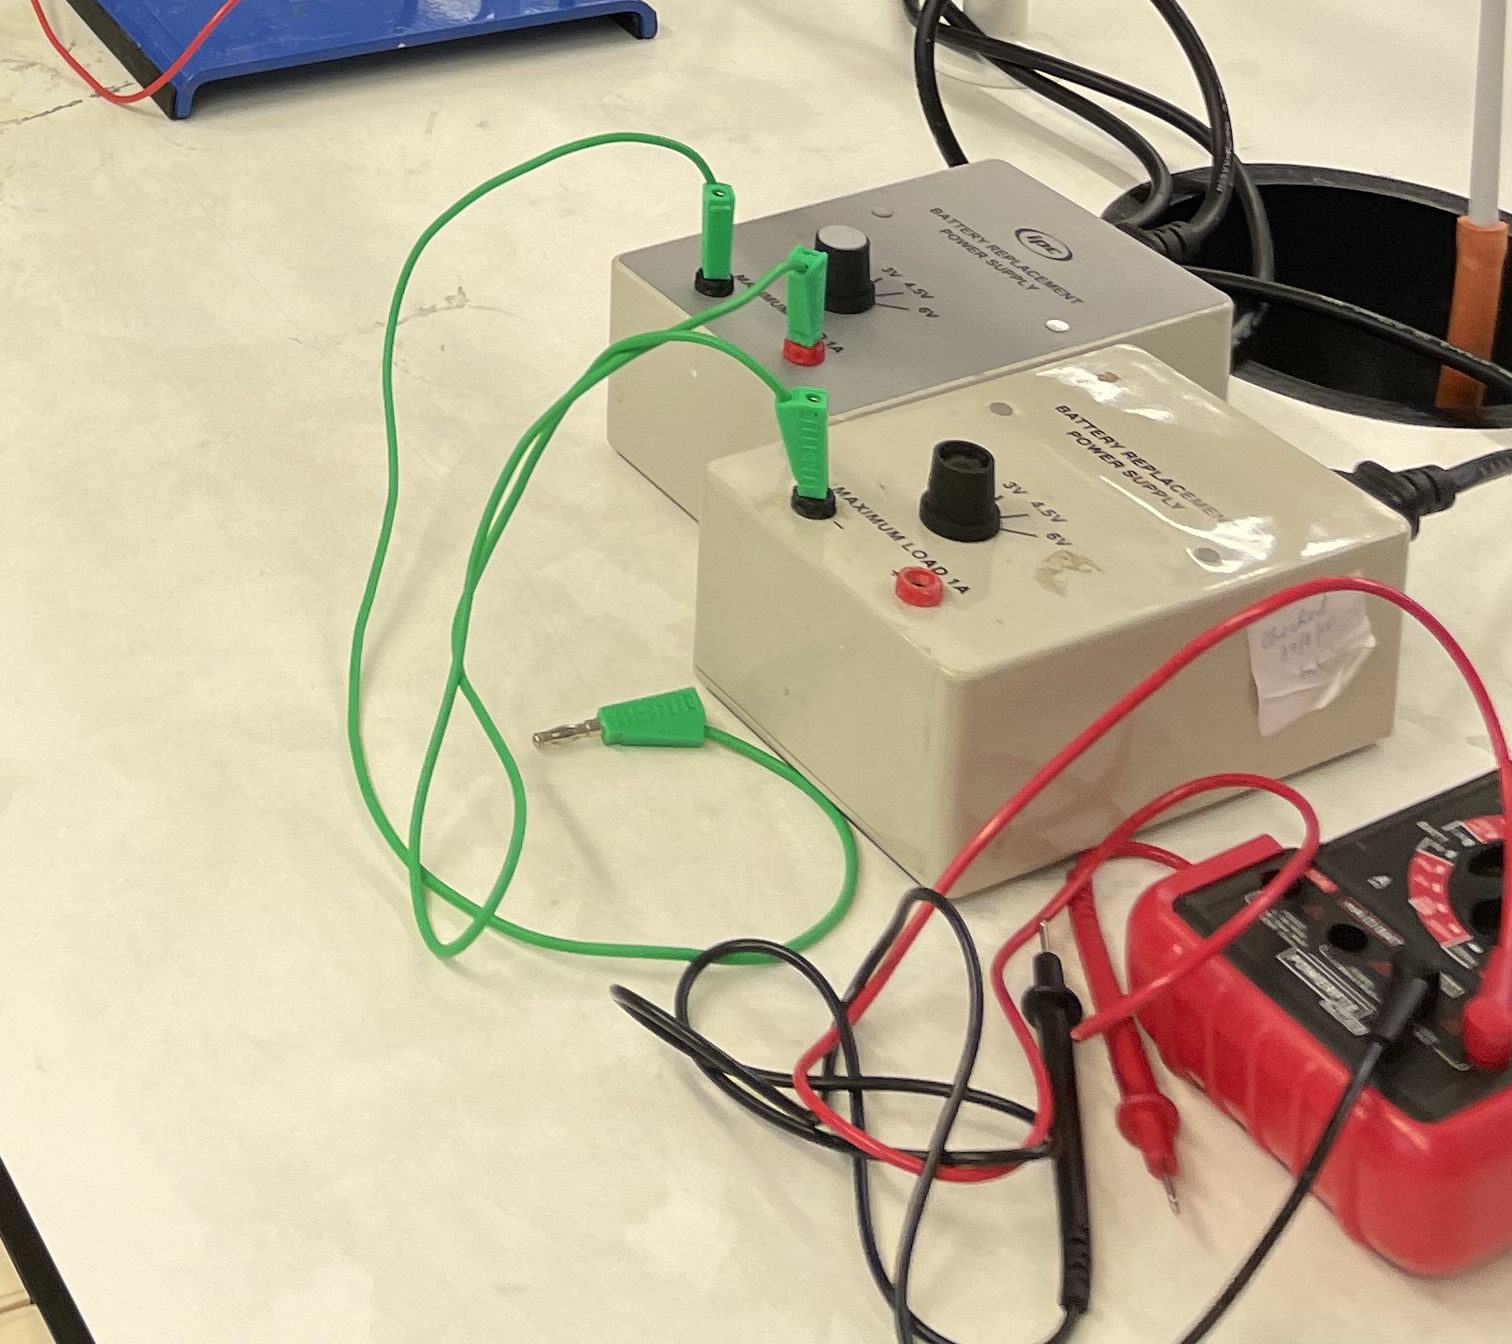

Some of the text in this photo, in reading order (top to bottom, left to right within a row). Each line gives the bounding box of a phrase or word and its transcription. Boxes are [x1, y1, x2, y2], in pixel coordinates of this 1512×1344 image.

[930, 207, 1084, 304] BATTERY REPLACEMENT
[939, 228, 1040, 290] POWER SUPPLY
[881, 266, 903, 278] 3V
[904, 281, 934, 299] 4.5V
[918, 306, 940, 319] 6V
[1055, 404, 1231, 523] BATTERY REPLACEMEN
[1066, 430, 1186, 512] POWER SUPPLY
[1002, 480, 1028, 496] 3V
[1030, 500, 1068, 525] 4.5V
[833, 486, 970, 595] MAXIMUM LOAD 1A
[1046, 531, 1072, 548] 6V
